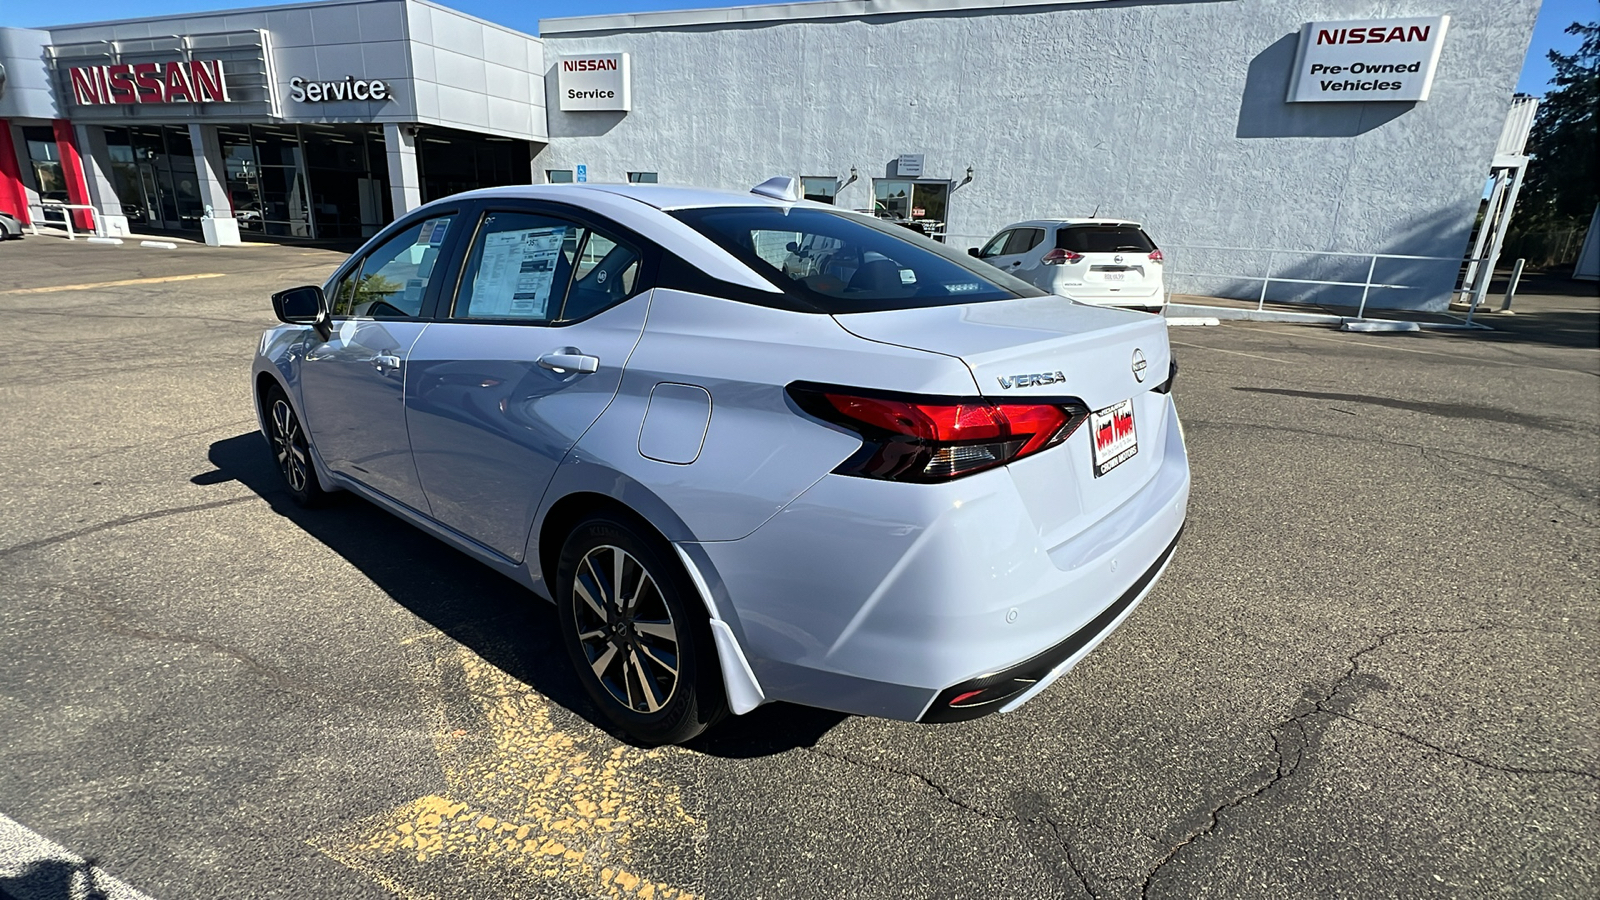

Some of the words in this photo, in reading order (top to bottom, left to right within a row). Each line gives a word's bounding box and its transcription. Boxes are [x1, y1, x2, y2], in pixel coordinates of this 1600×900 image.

[1317, 25, 1430, 45] NISSAN
[563, 59, 617, 72] NISSAN
[1310, 61, 1421, 75] Pre-Owned
[69, 59, 227, 105] NISSAN
[289, 75, 387, 103] Service
[1320, 79, 1402, 91] Vehicles
[567, 89, 615, 99] Service
[996, 371, 1067, 390] VERSA
